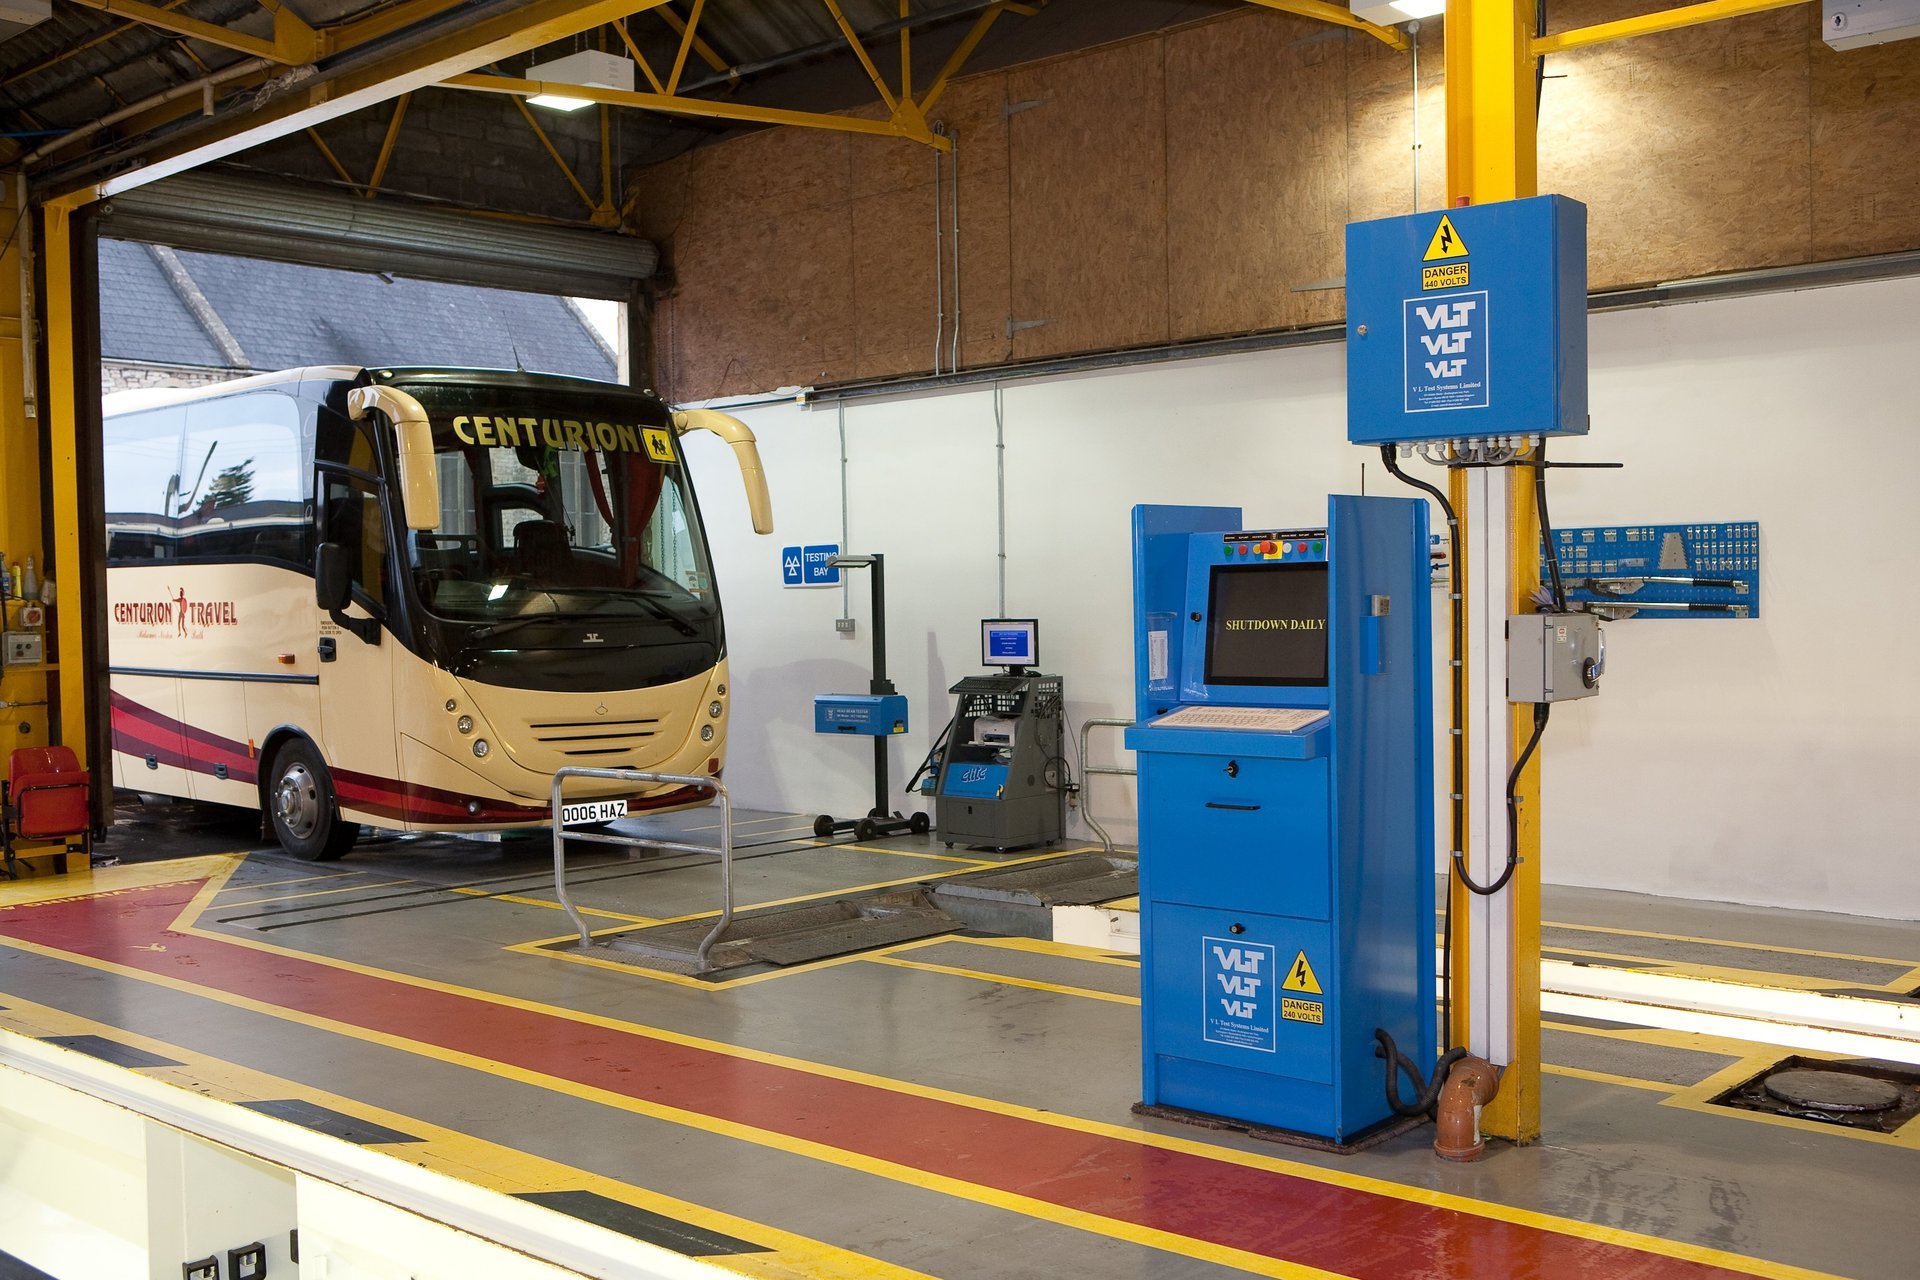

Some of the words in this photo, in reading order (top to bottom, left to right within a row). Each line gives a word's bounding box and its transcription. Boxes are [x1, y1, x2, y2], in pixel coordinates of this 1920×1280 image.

[1424, 265, 1467, 278] DANGER
[1425, 280, 1438, 288] 440
[1440, 277, 1467, 286] VOLTS
[1416, 301, 1476, 330] VLT
[1420, 331, 1472, 356] VLT
[1425, 359, 1467, 379] VLT
[1436, 383, 1458, 392] Systems
[1460, 381, 1481, 389] Limited
[452, 416, 641, 453] CENTURION
[813, 567, 829, 577] BAY
[114, 602, 172, 627] CENTURION
[189, 602, 238, 627] TRAVEL
[1225, 619, 1288, 631] SHUTDOWN
[1290, 619, 1326, 630] DAILY
[600, 803, 625, 818] HAZ
[1213, 946, 1265, 974] VLT
[1217, 973, 1261, 998] VLT
[1221, 998, 1257, 1019] VLT
[1283, 1000, 1322, 1012] DANGER
[1283, 1010, 1296, 1018] 240
[1297, 1012, 1321, 1022] VOLTS
[1220, 1019, 1230, 1027] Test
[1231, 1021, 1250, 1030] Systems
[1250, 1025, 1269, 1033] Limited
